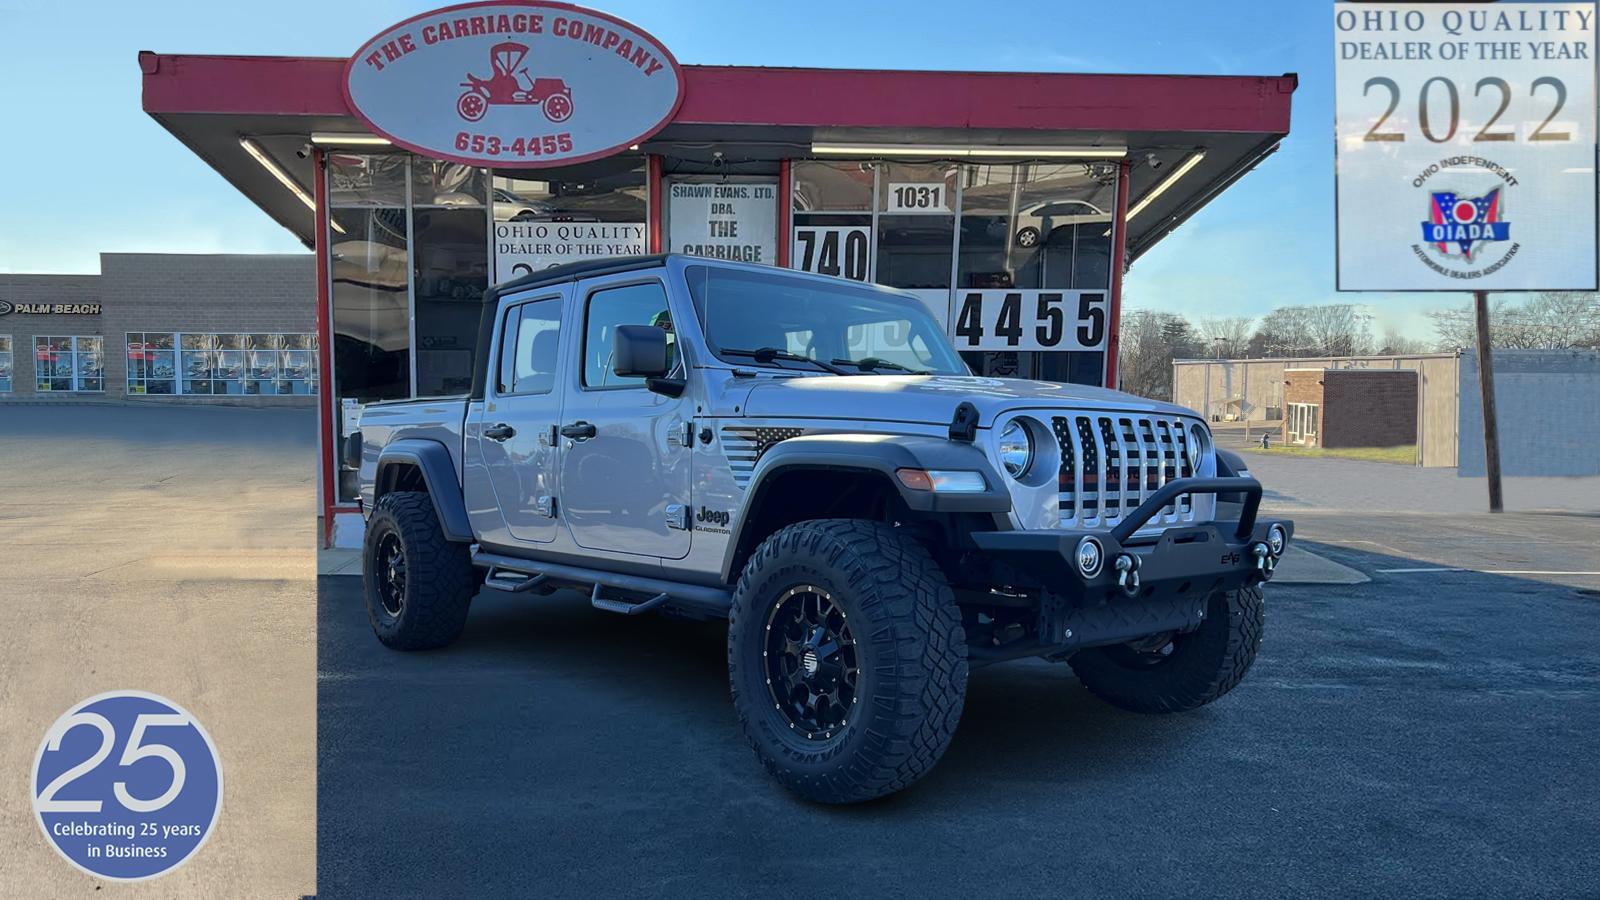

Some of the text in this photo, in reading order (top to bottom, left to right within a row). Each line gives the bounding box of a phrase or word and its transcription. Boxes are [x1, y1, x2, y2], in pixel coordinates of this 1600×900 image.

[1336, 10, 1593, 35] OHIO QUALITY
[366, 15, 664, 77] THE CARRIAGE COMPANY
[1340, 42, 1589, 60] DEALER OF THE YEAR
[1362, 76, 1571, 143] 2022
[455, 132, 573, 157] 653-4455
[1412, 156, 1519, 188] OHIO INDEPENDENT
[673, 186, 712, 198] SHAWN
[754, 187, 775, 199] LTD.
[894, 186, 941, 208] 1031
[711, 203, 736, 215] DBA.
[497, 226, 644, 241] OHIO QUALITY
[708, 220, 738, 238] THE
[1432, 224, 1495, 240] OIADA
[500, 243, 641, 255] DEALER OF THE YEAR
[683, 244, 762, 262] CARRIAGE
[798, 230, 868, 281] 740
[1449, 269, 1482, 279] DEALERS
[1482, 242, 1520, 277] ASSOCIATION
[14, 303, 100, 314] PALM BEACH
[956, 293, 1105, 347] 4455
[697, 506, 729, 527] Jeep
[695, 526, 731, 535] GLADIATOR
